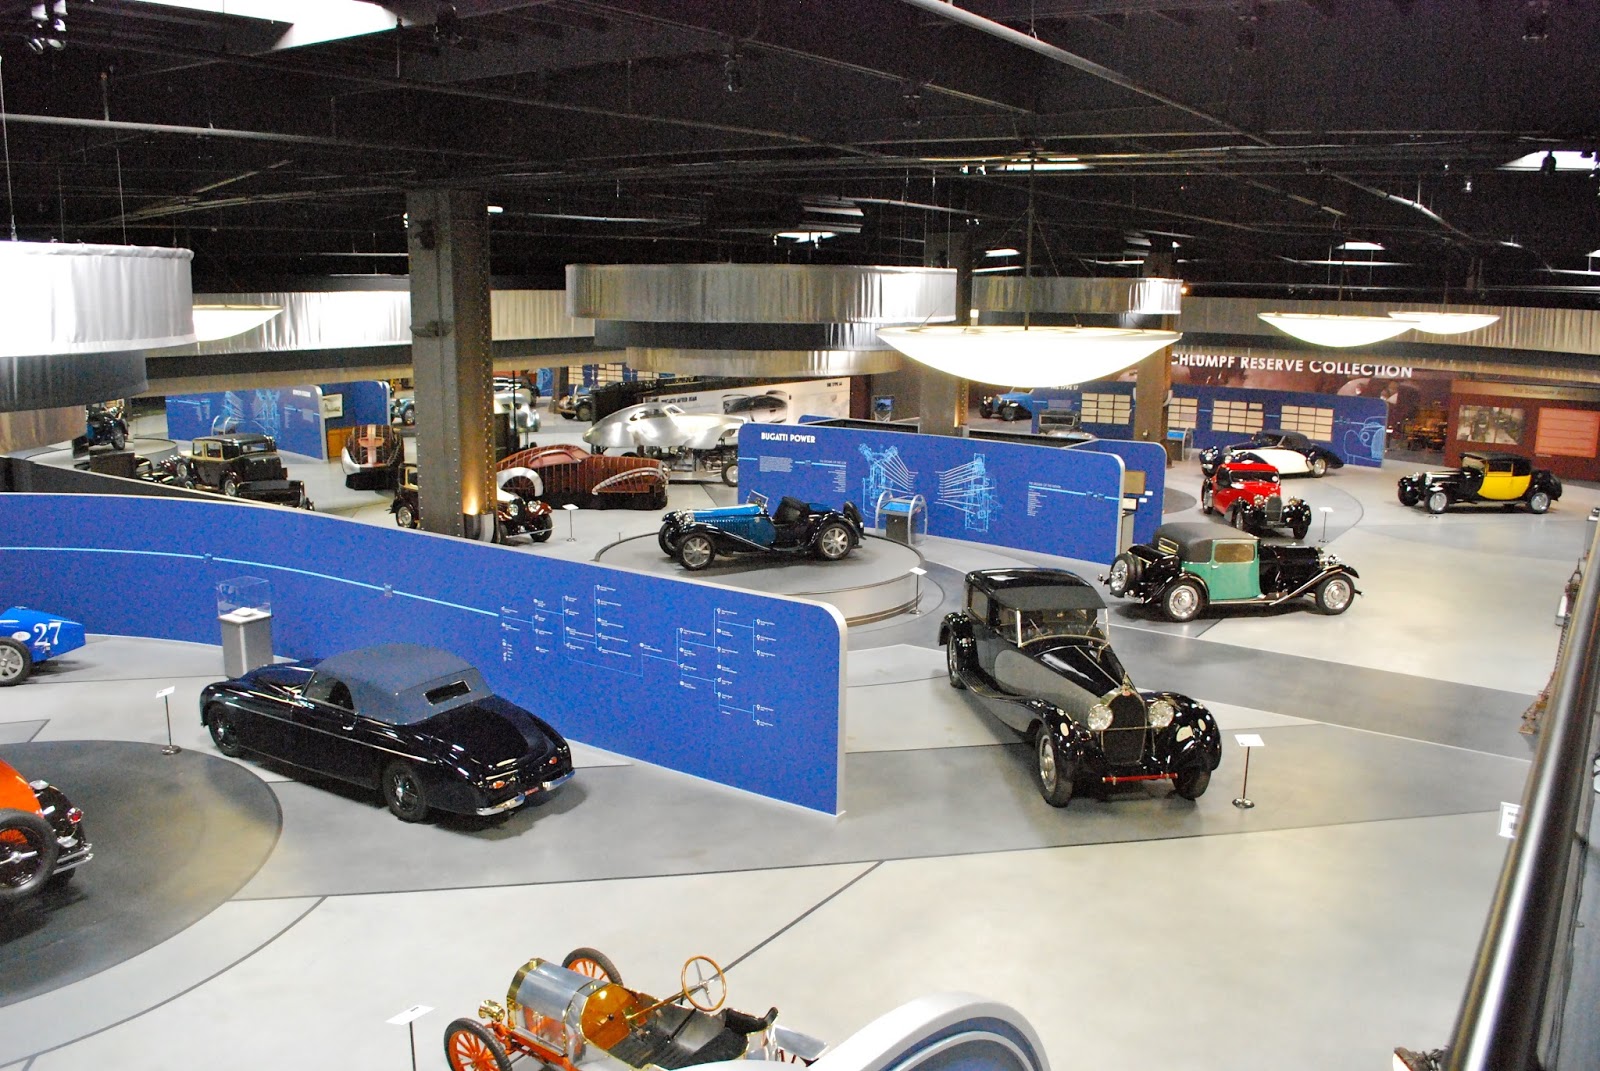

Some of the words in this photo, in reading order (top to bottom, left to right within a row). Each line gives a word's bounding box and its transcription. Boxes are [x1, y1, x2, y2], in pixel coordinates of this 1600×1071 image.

[1240, 356, 1304, 372] RESERVE
[1308, 360, 1413, 378] COLLECTION
[761, 432, 789, 442] BUGATTI
[790, 433, 816, 444] POWER
[33, 621, 62, 647] 27
